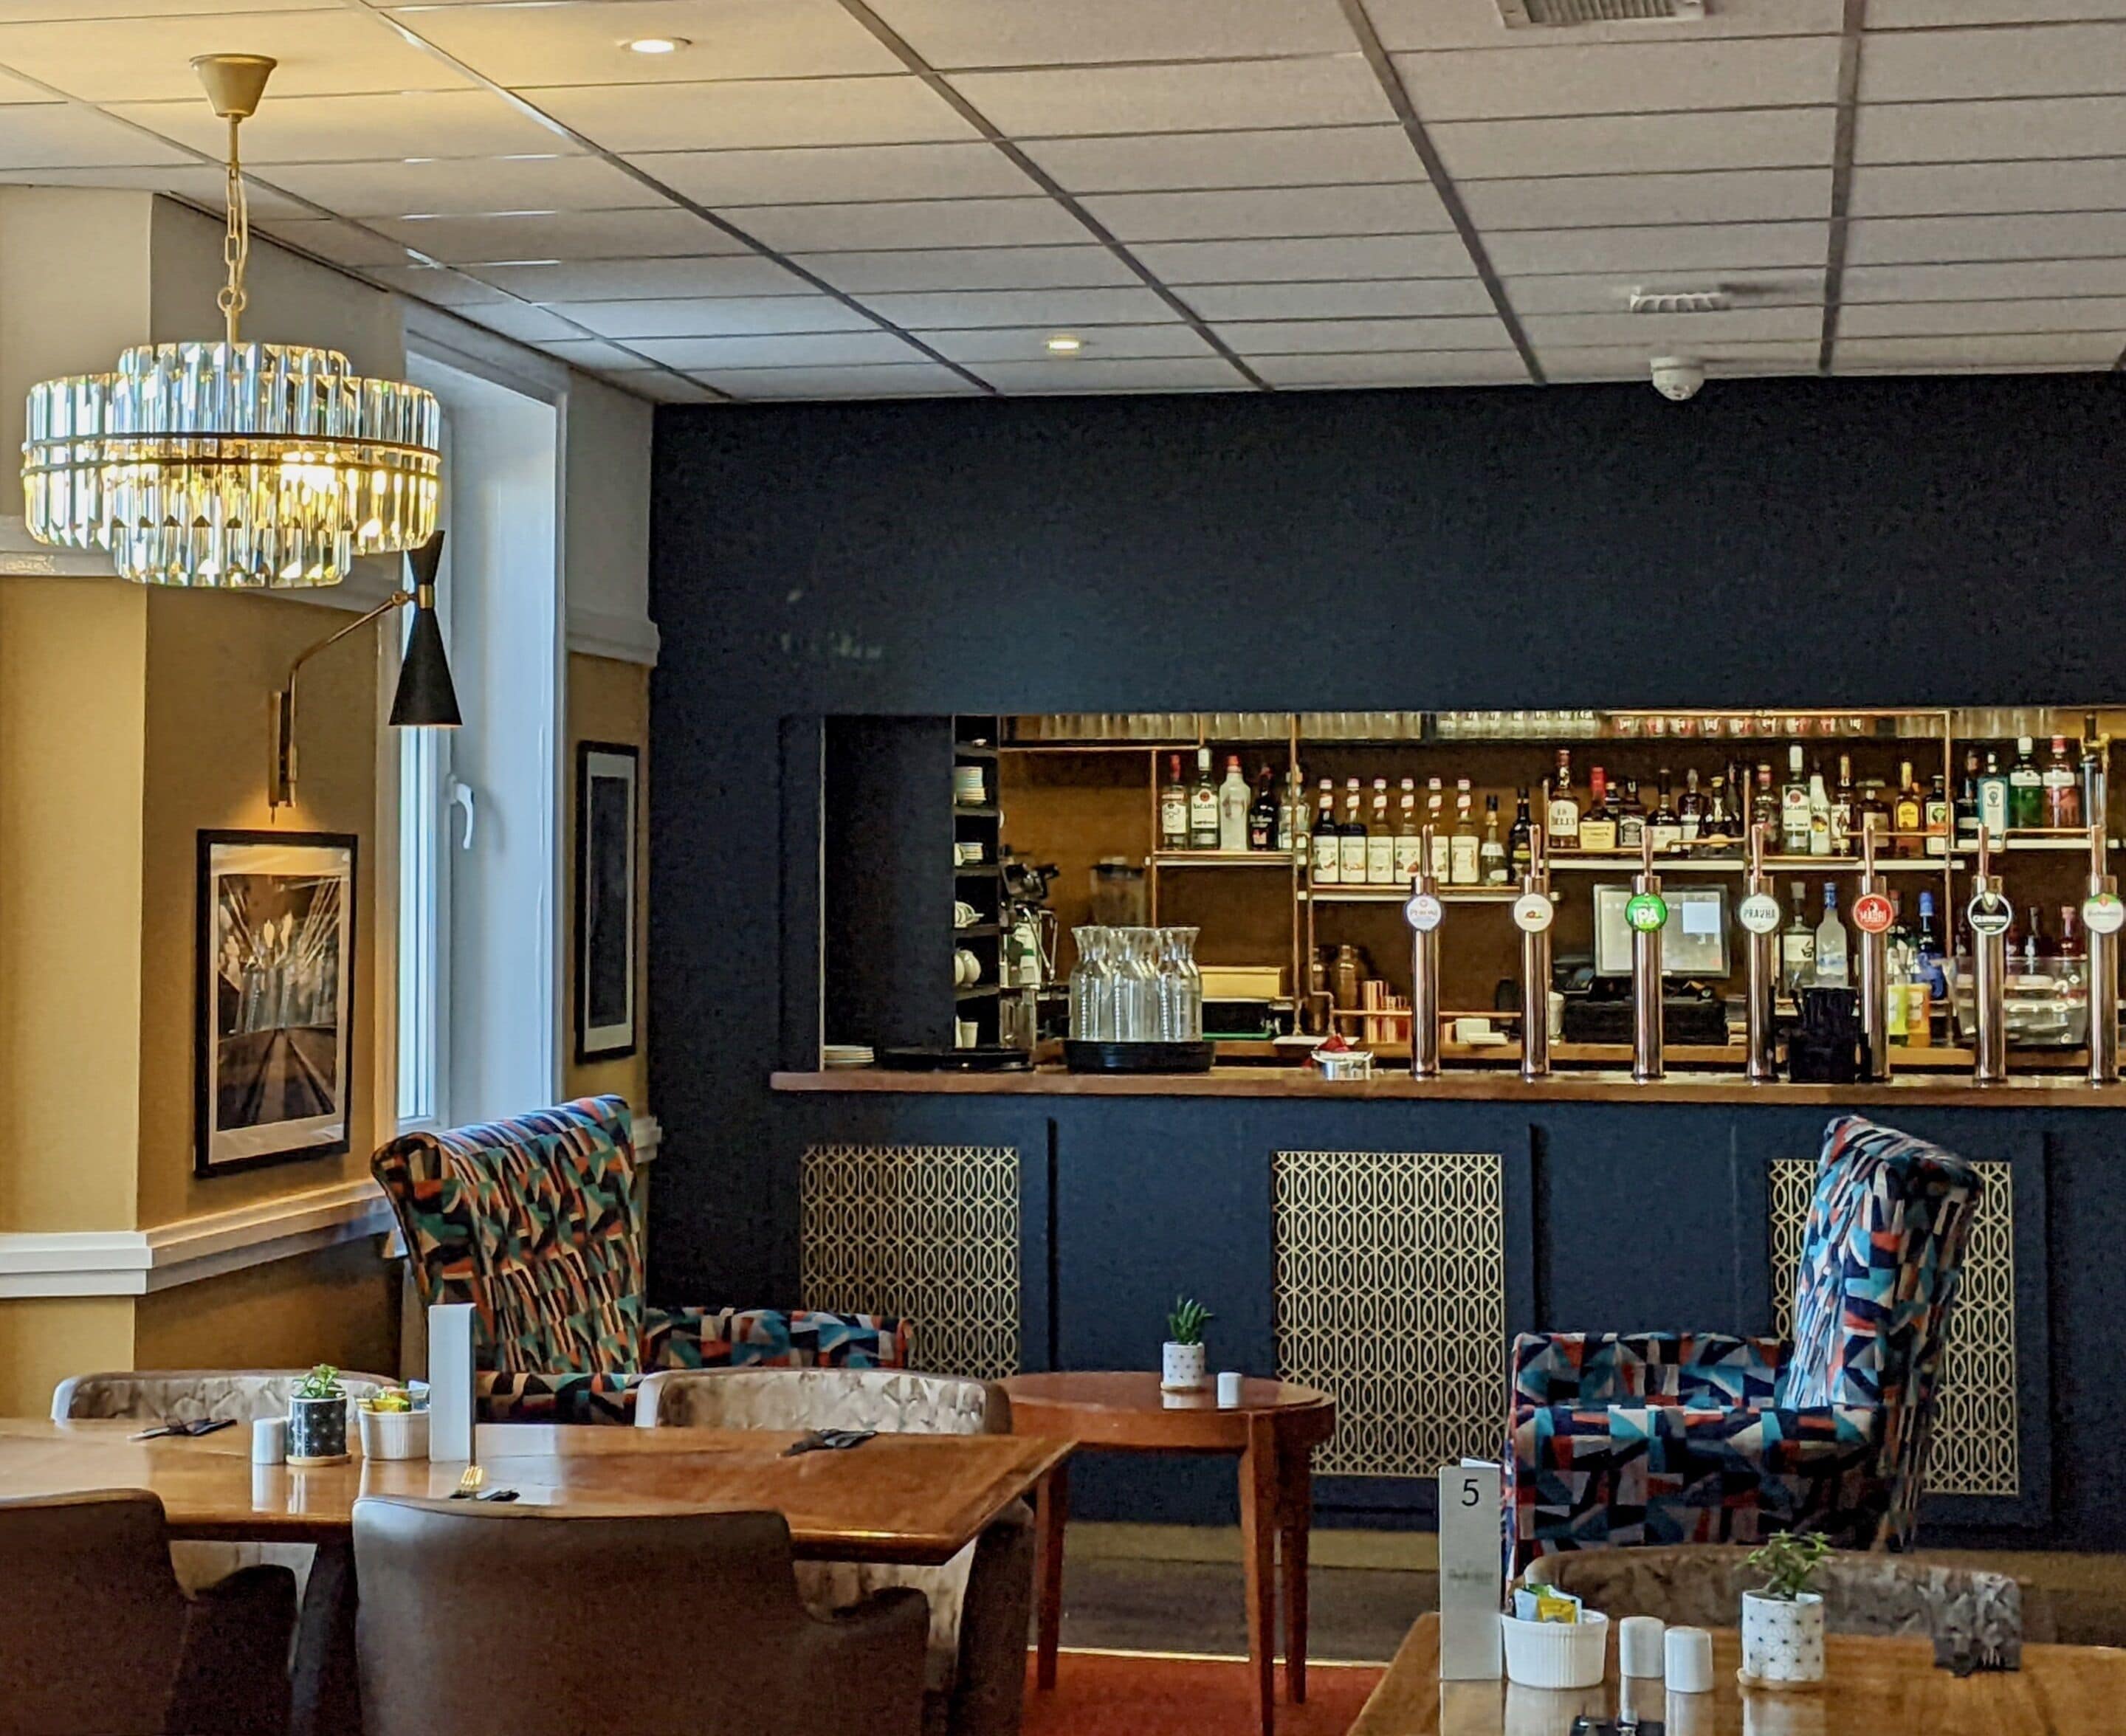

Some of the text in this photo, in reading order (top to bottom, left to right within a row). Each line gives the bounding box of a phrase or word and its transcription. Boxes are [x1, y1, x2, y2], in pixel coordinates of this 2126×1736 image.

[1632, 908, 1660, 926] IPA
[1743, 909, 1775, 919] PRAVHA
[1462, 1478, 1479, 1506] 5
